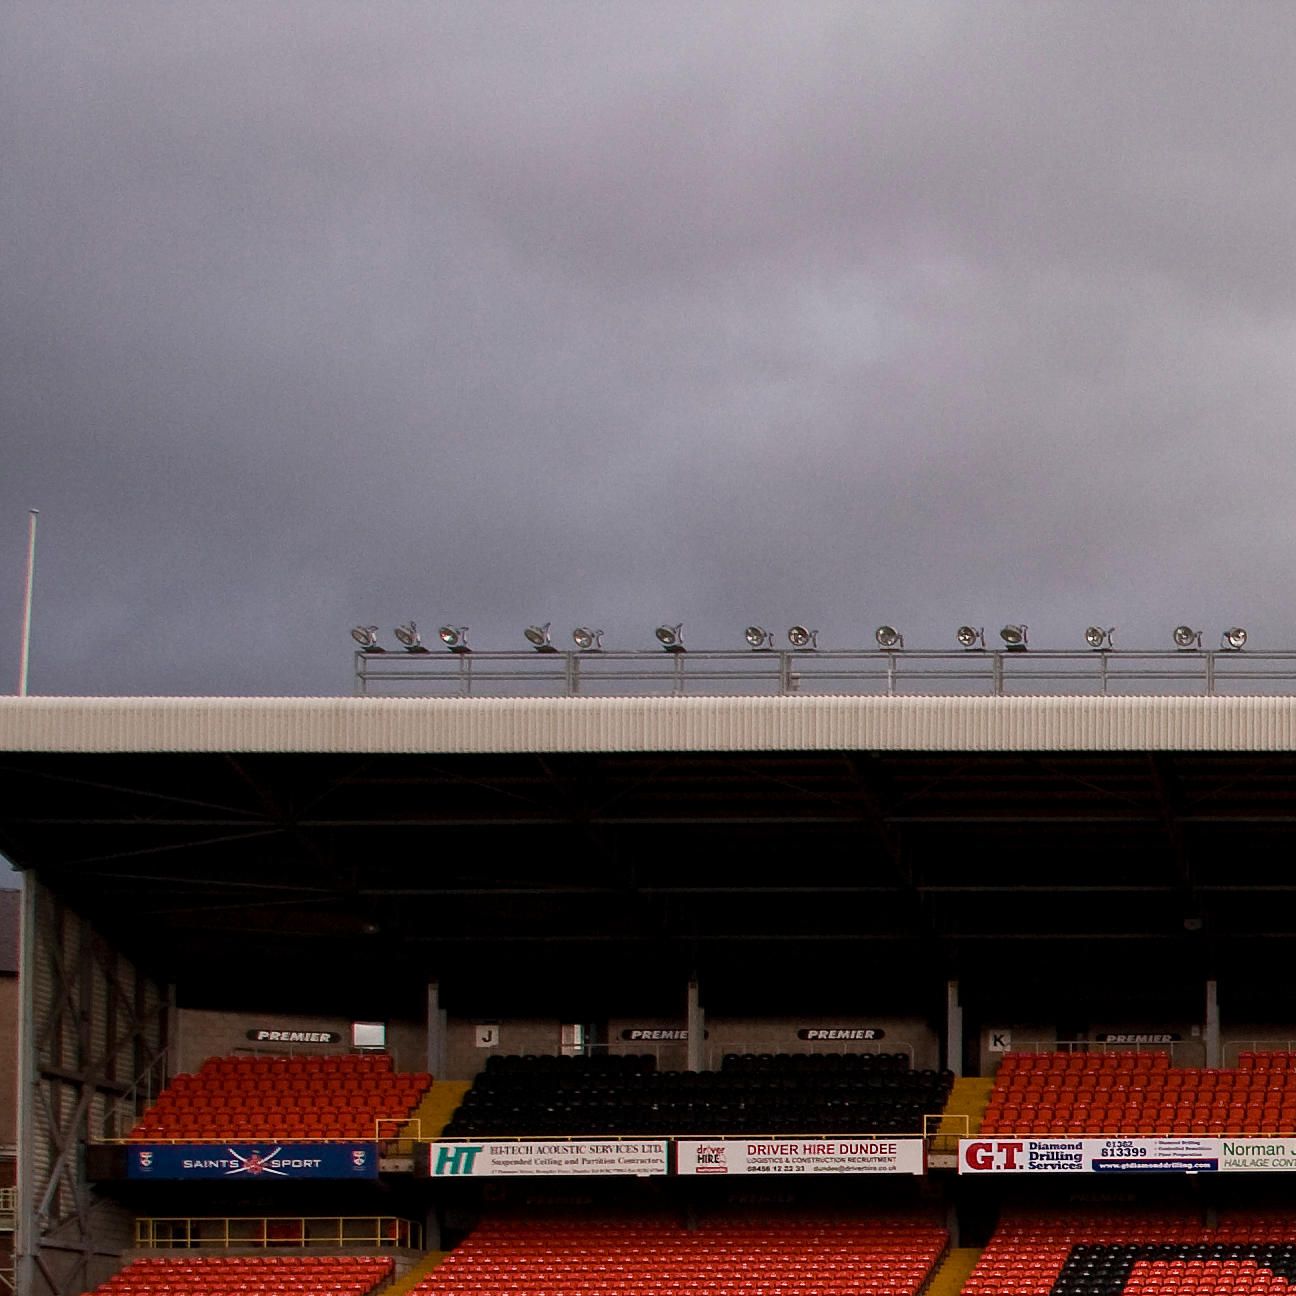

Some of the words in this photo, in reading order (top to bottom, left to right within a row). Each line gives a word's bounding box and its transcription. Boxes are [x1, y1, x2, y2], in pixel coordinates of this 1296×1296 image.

[257, 1030, 331, 1043] PREMIER
[482, 1030, 493, 1043] J
[631, 1030, 688, 1041] PREMIE
[808, 1030, 875, 1040] PREMIER
[993, 1034, 1005, 1047] K
[1106, 1034, 1172, 1043] PREMIER
[536, 1145, 587, 1155] ACOUSTIC
[589, 1144, 639, 1154] SERVICES
[697, 1144, 725, 1155] driver
[747, 1144, 798, 1155] DRIVER
[802, 1144, 835, 1155] HIRE
[840, 1143, 897, 1155] DUNDEE
[1029, 1141, 1083, 1150] Diamond
[1223, 1142, 1285, 1156] Norman
[435, 1146, 485, 1175] HT
[491, 1158, 532, 1167] Suspended
[534, 1158, 562, 1166] Ceiling
[581, 1157, 616, 1165] Partition
[697, 1154, 720, 1164] HIRE
[1029, 1151, 1083, 1163] Drilling
[183, 1159, 239, 1168] SAINTS
[272, 1159, 322, 1168] SPORT
[1028, 1161, 1083, 1170] Services
[1224, 1159, 1270, 1167] HAULAGE
